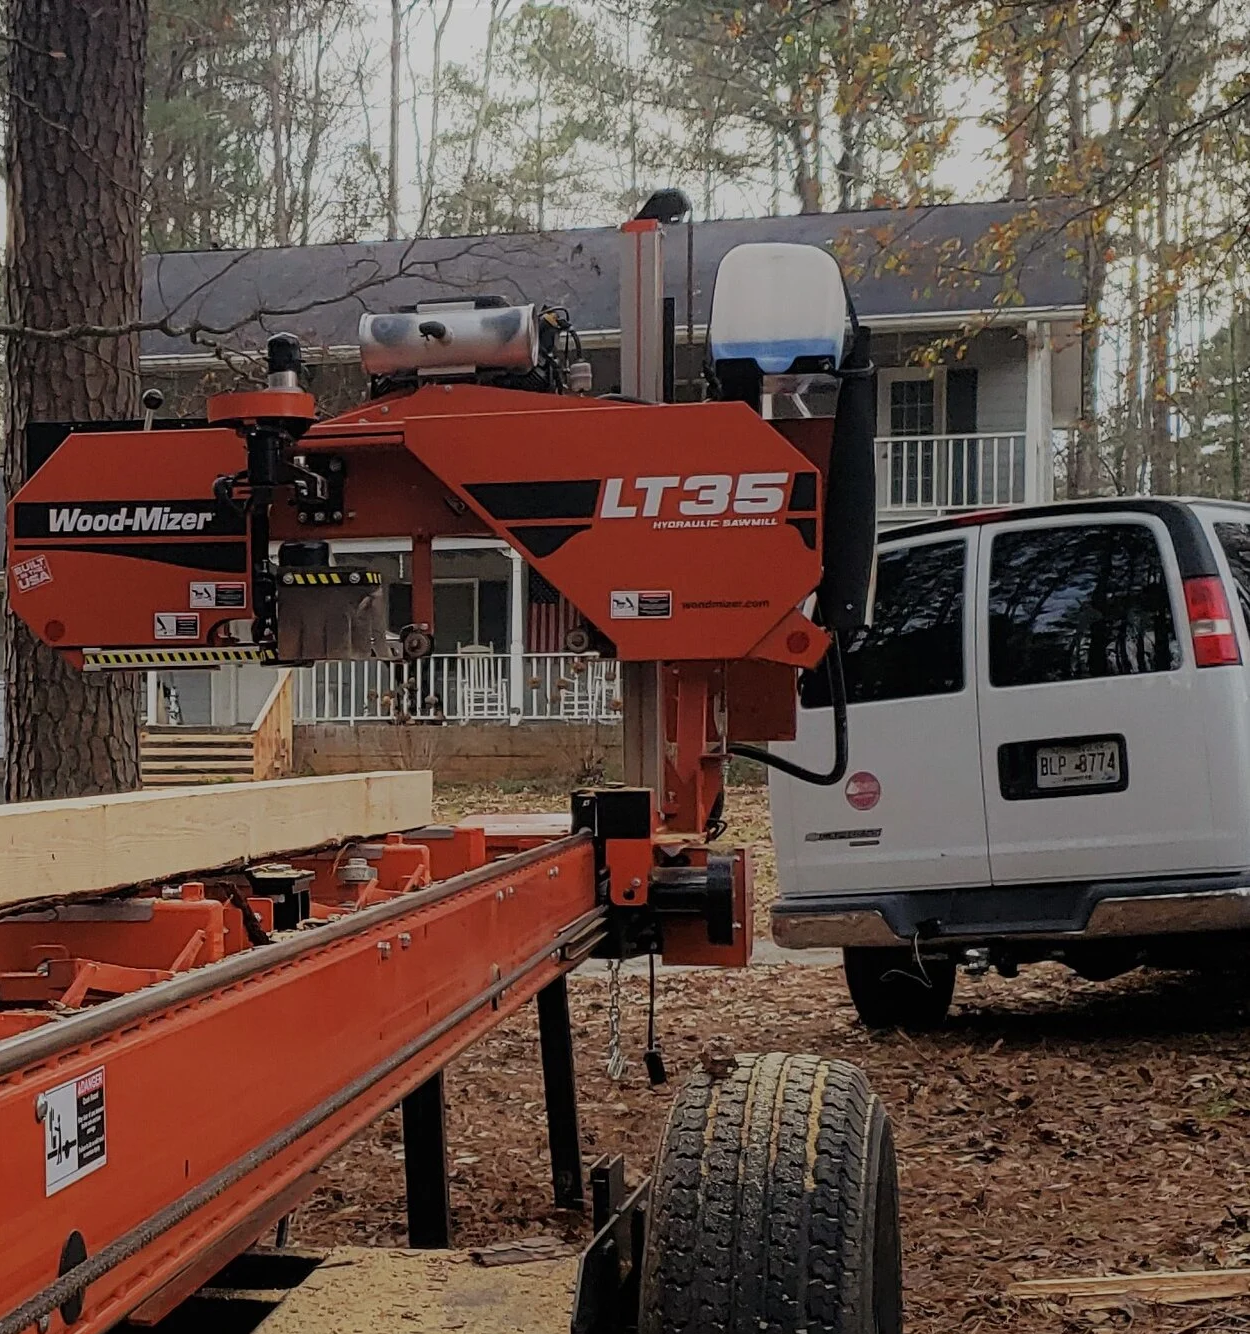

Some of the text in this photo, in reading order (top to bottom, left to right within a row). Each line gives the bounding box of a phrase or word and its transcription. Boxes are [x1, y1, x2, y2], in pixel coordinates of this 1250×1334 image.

[600, 472, 789, 519] LT35
[49, 507, 212, 532] Wood-Mizer
[653, 517, 778, 530] HYDRAULIC SAWMILL
[14, 557, 45, 576] BUILT
[18, 571, 51, 590] USA
[683, 600, 769, 609] woodmizer.com
[1040, 755, 1067, 777] BLP
